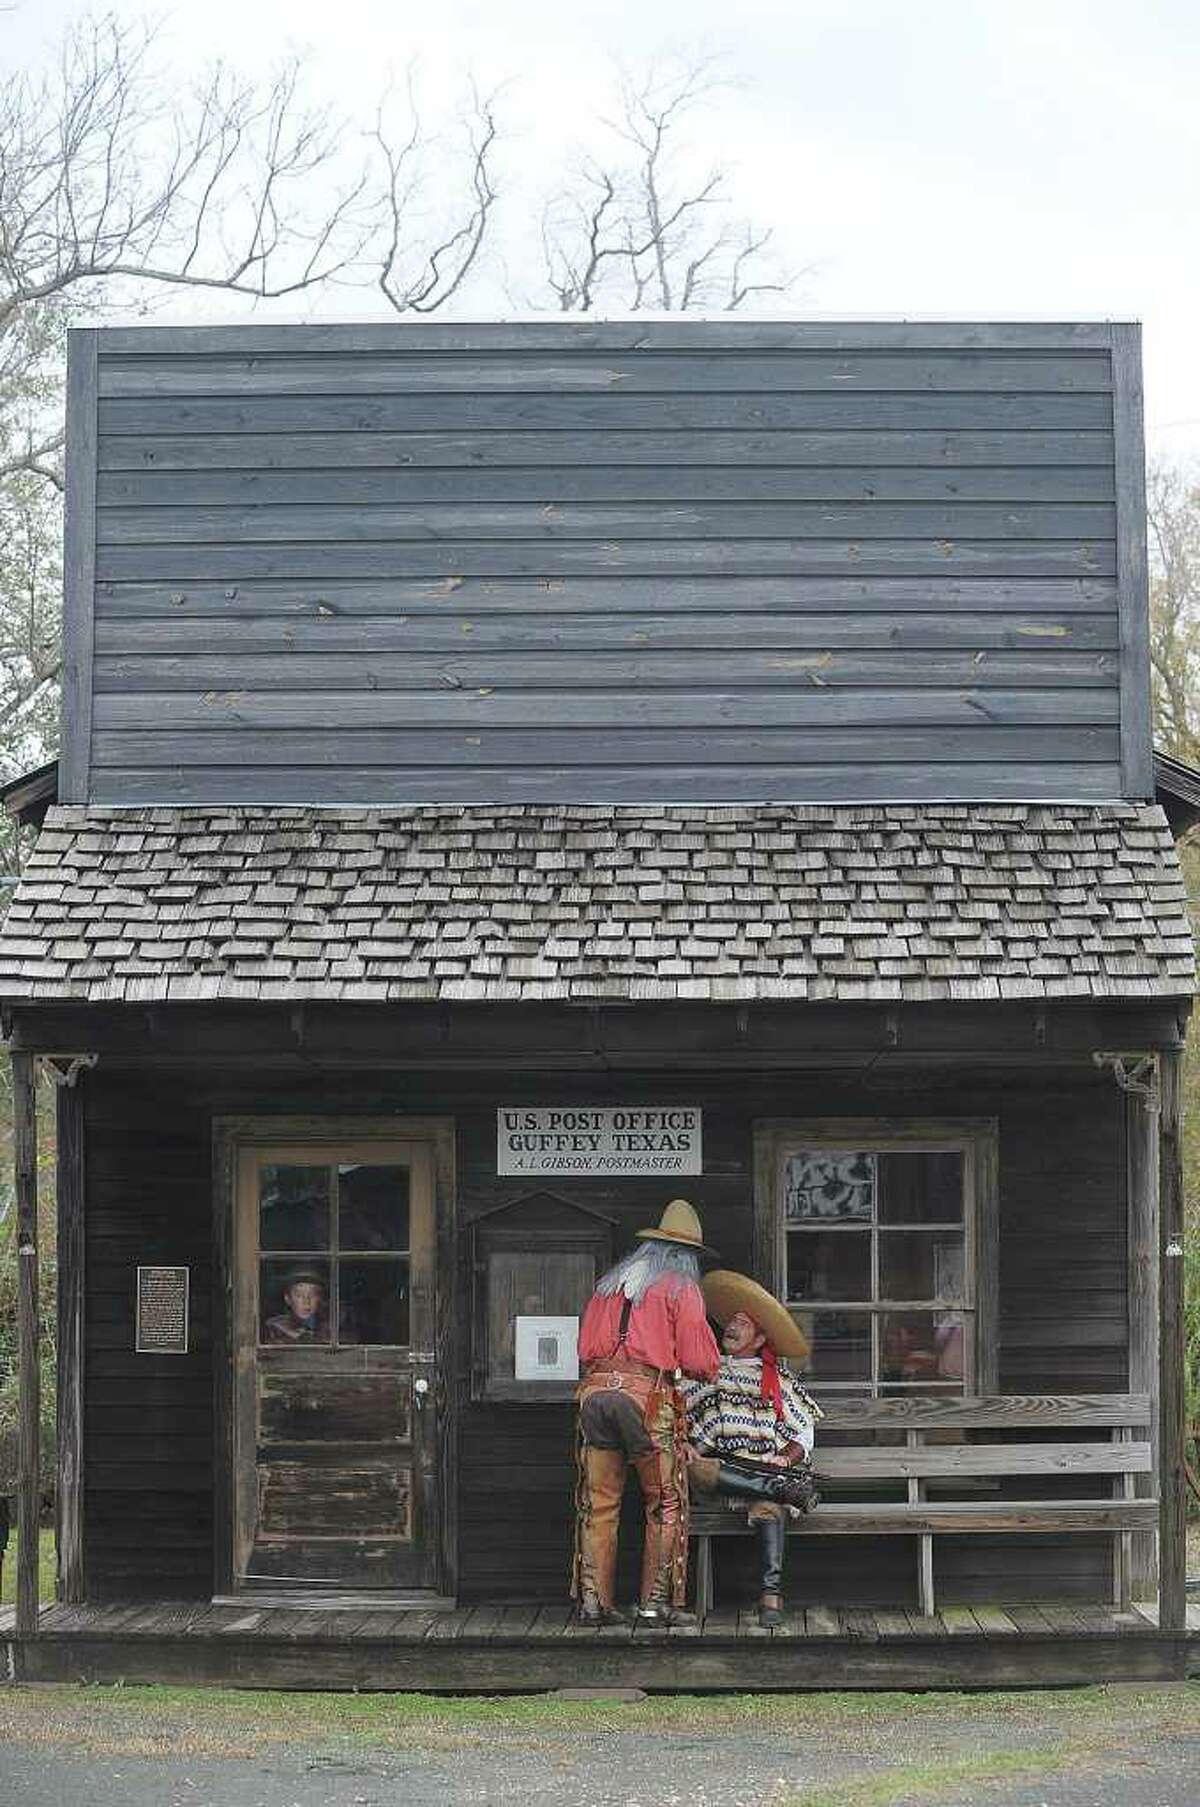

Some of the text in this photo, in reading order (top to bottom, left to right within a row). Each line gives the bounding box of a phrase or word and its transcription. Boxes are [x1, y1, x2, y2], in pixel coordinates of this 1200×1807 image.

[503, 1111, 696, 1130] U.S. POST OFFICE
[508, 1133, 691, 1151] GUFFEY TEXAS
[596, 1156, 682, 1169] POSTMASTER
